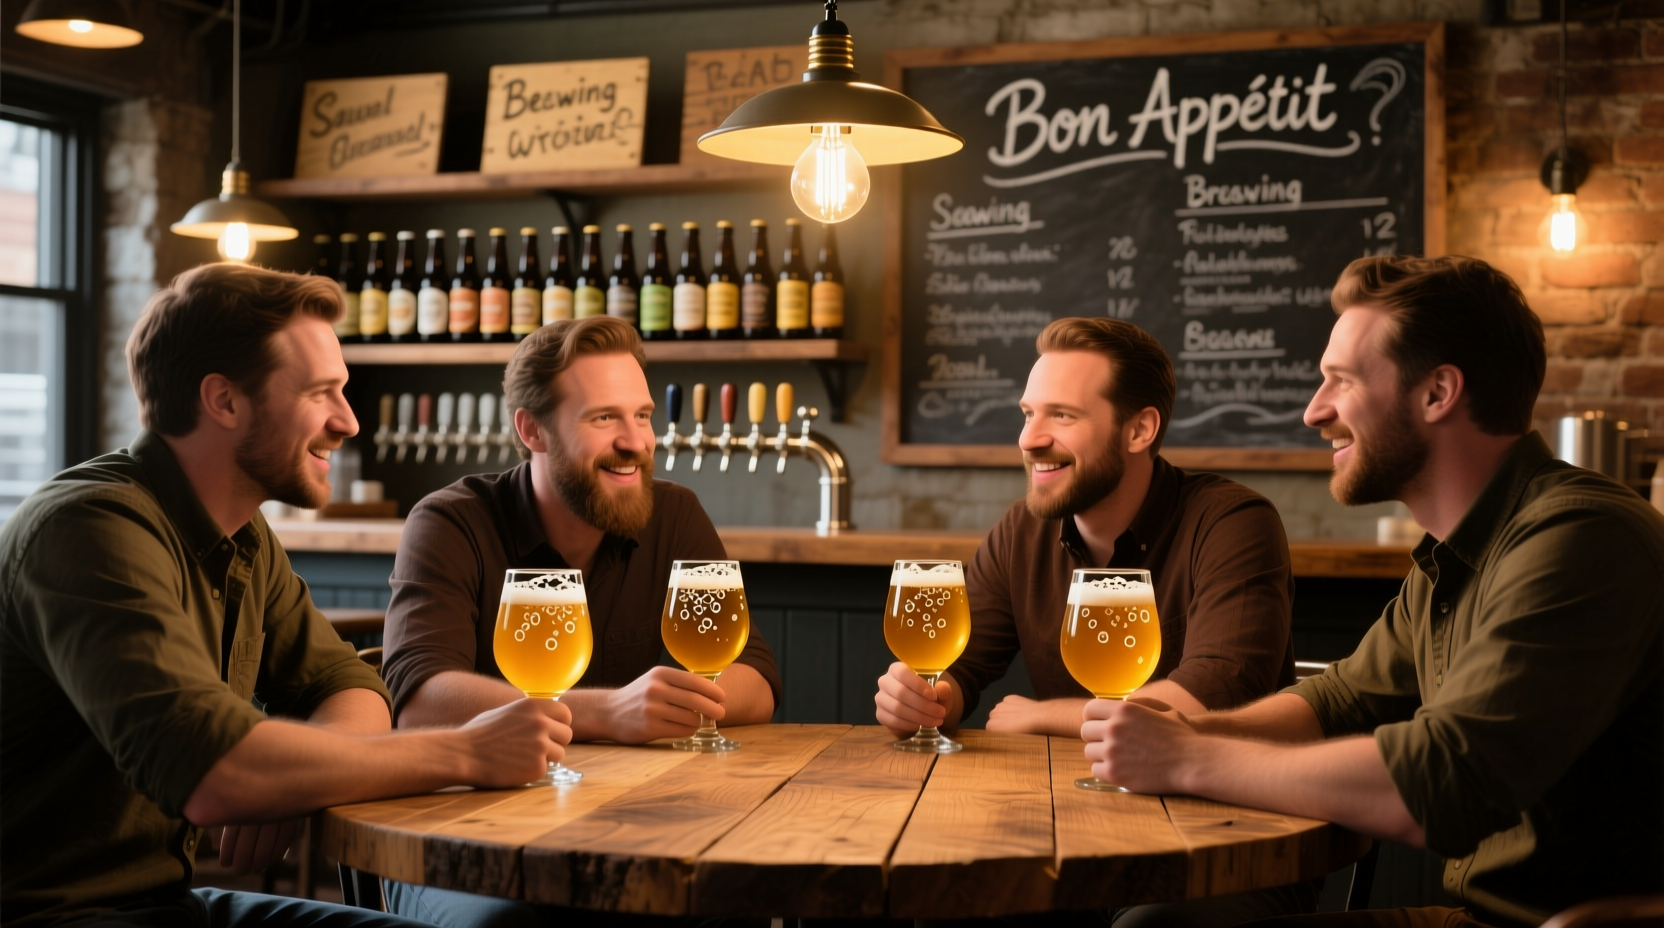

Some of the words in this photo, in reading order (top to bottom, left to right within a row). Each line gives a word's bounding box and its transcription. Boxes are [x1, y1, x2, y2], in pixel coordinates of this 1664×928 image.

[985, 78, 1118, 167] Bon
[1127, 61, 1337, 168] Appétit
[1360, 211, 1398, 240] 12
